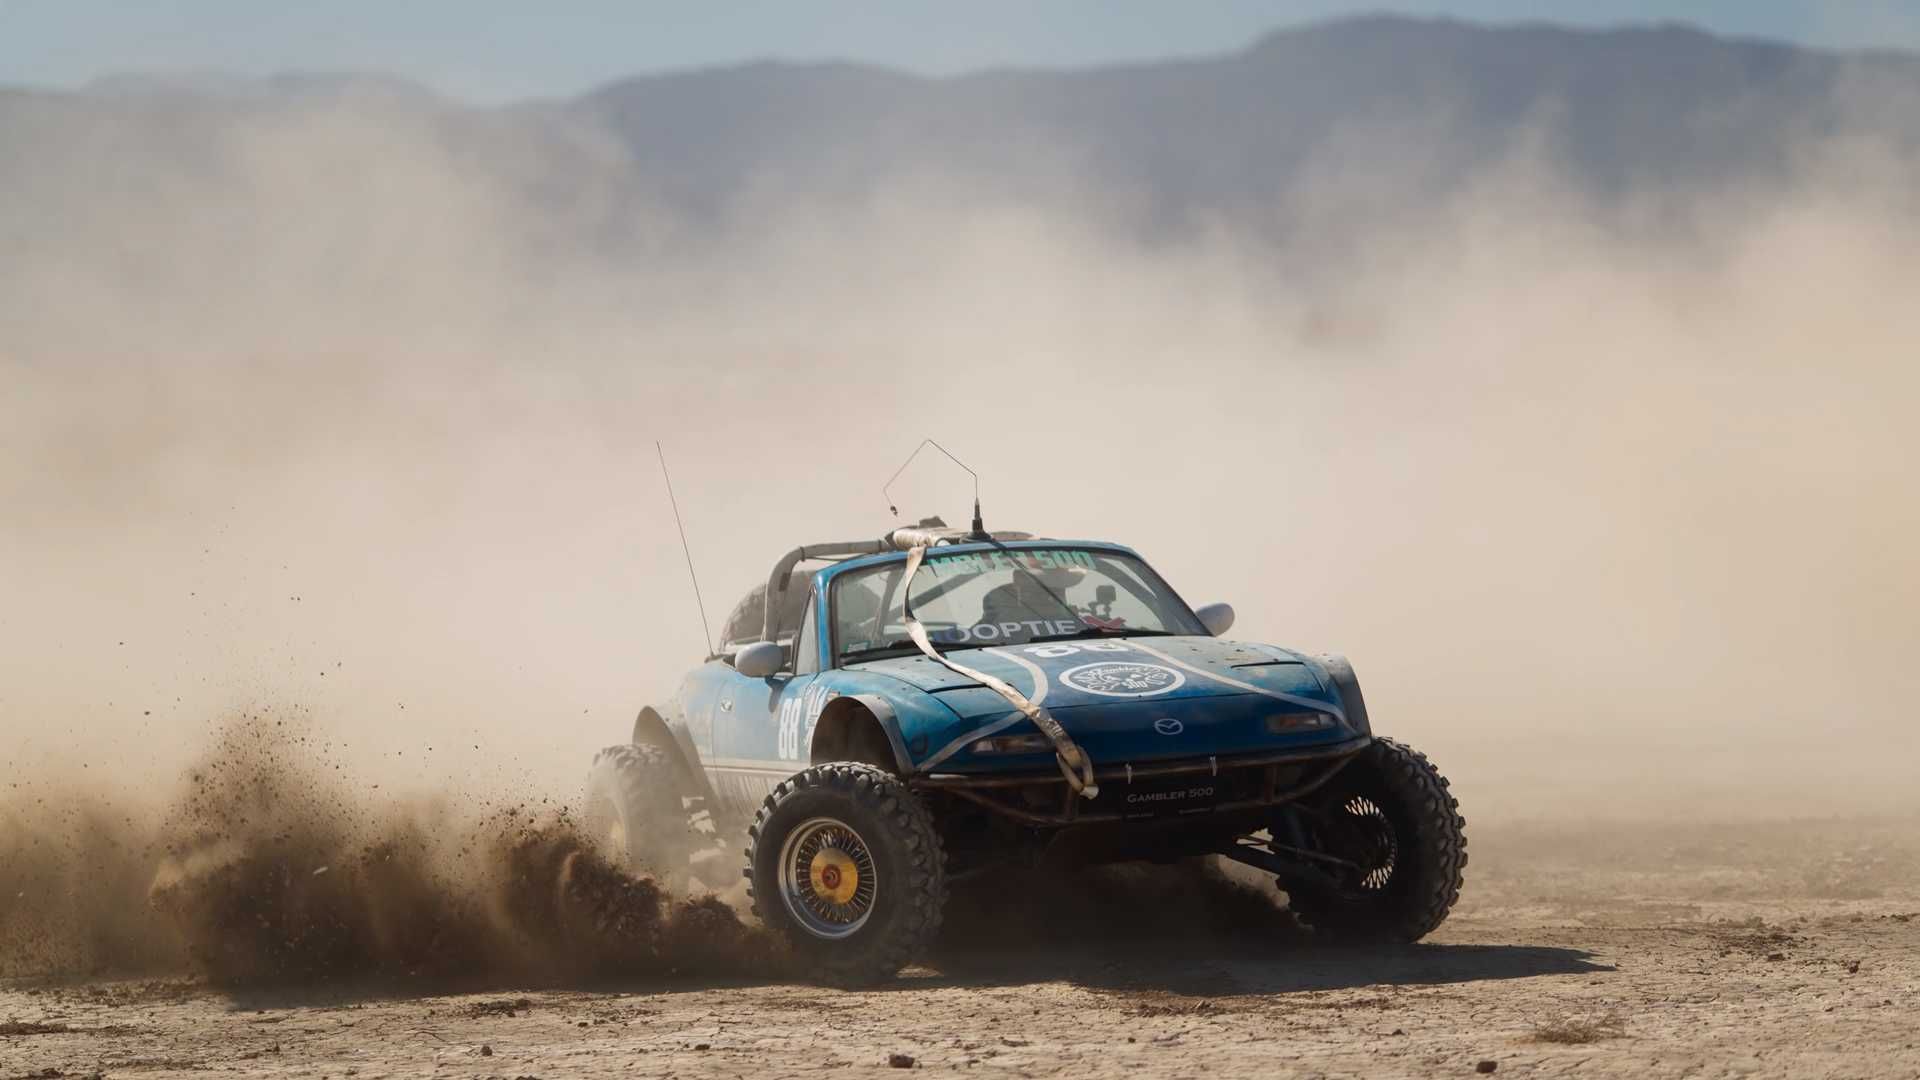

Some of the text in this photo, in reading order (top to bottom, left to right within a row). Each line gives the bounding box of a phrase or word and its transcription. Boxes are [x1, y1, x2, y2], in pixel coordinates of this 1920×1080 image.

[778, 697, 803, 760] 88
[1126, 786, 1215, 804] GAMBLER 500
